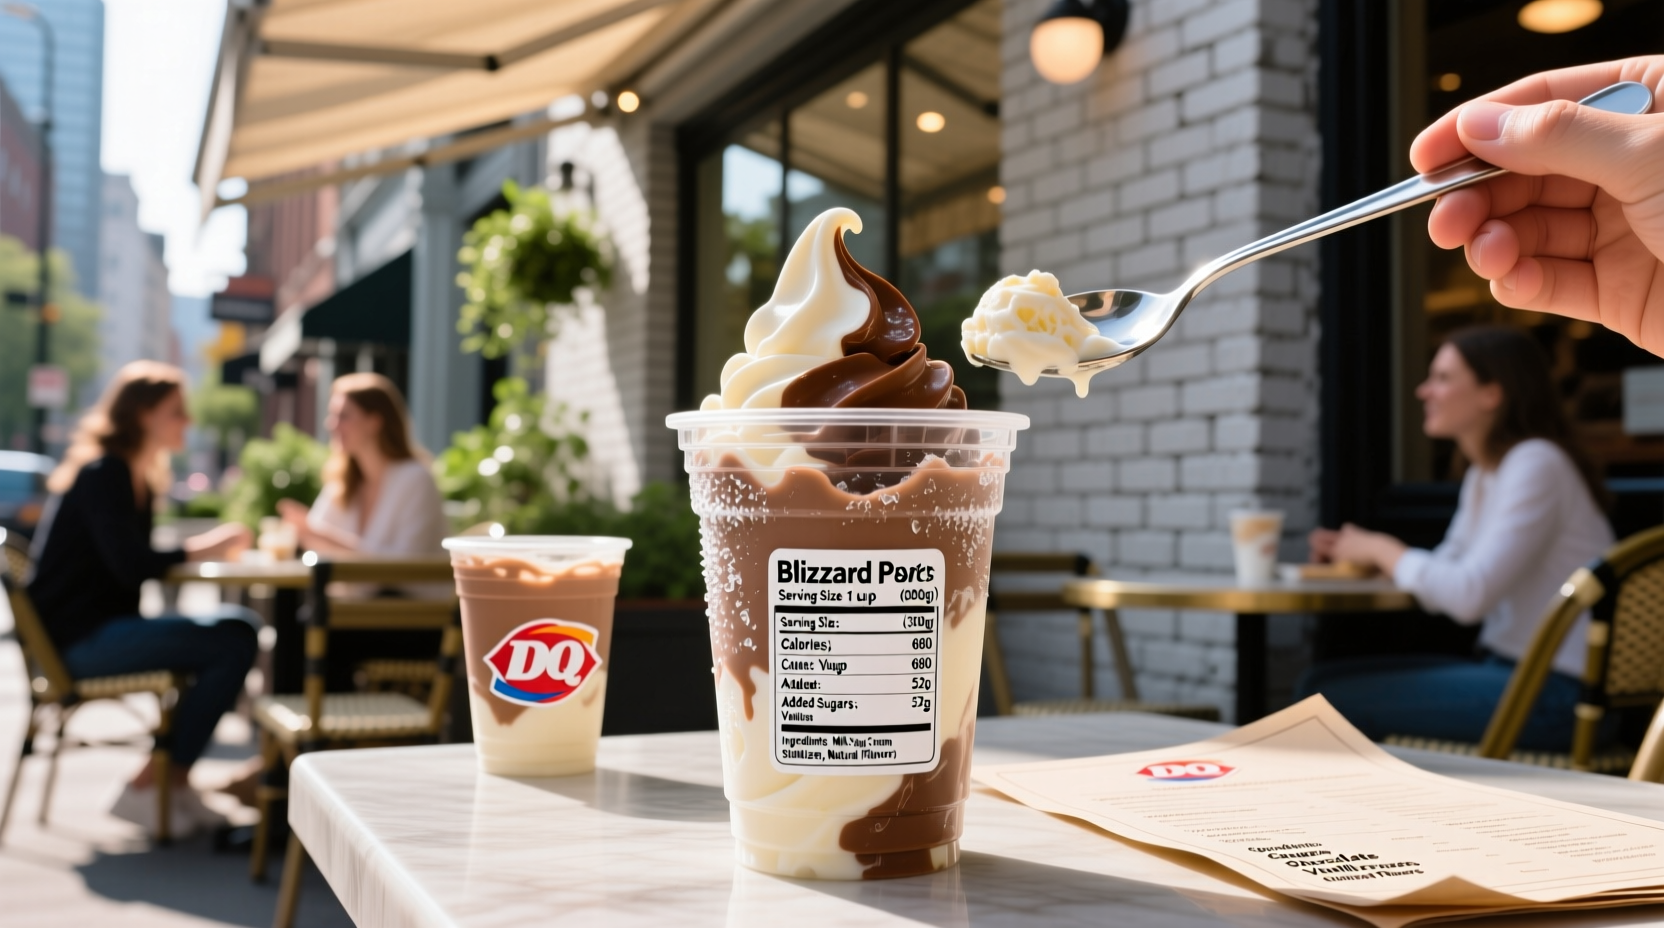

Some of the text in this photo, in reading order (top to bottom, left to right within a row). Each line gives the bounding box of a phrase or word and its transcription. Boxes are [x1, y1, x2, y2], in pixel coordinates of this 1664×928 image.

[777, 559, 872, 584] Blizzard
[778, 589, 818, 605] Serving
[820, 589, 843, 602] Size
[912, 637, 933, 650] 680
[504, 639, 582, 687] DQ
[911, 657, 932, 670] 680
[781, 695, 815, 709] Added
